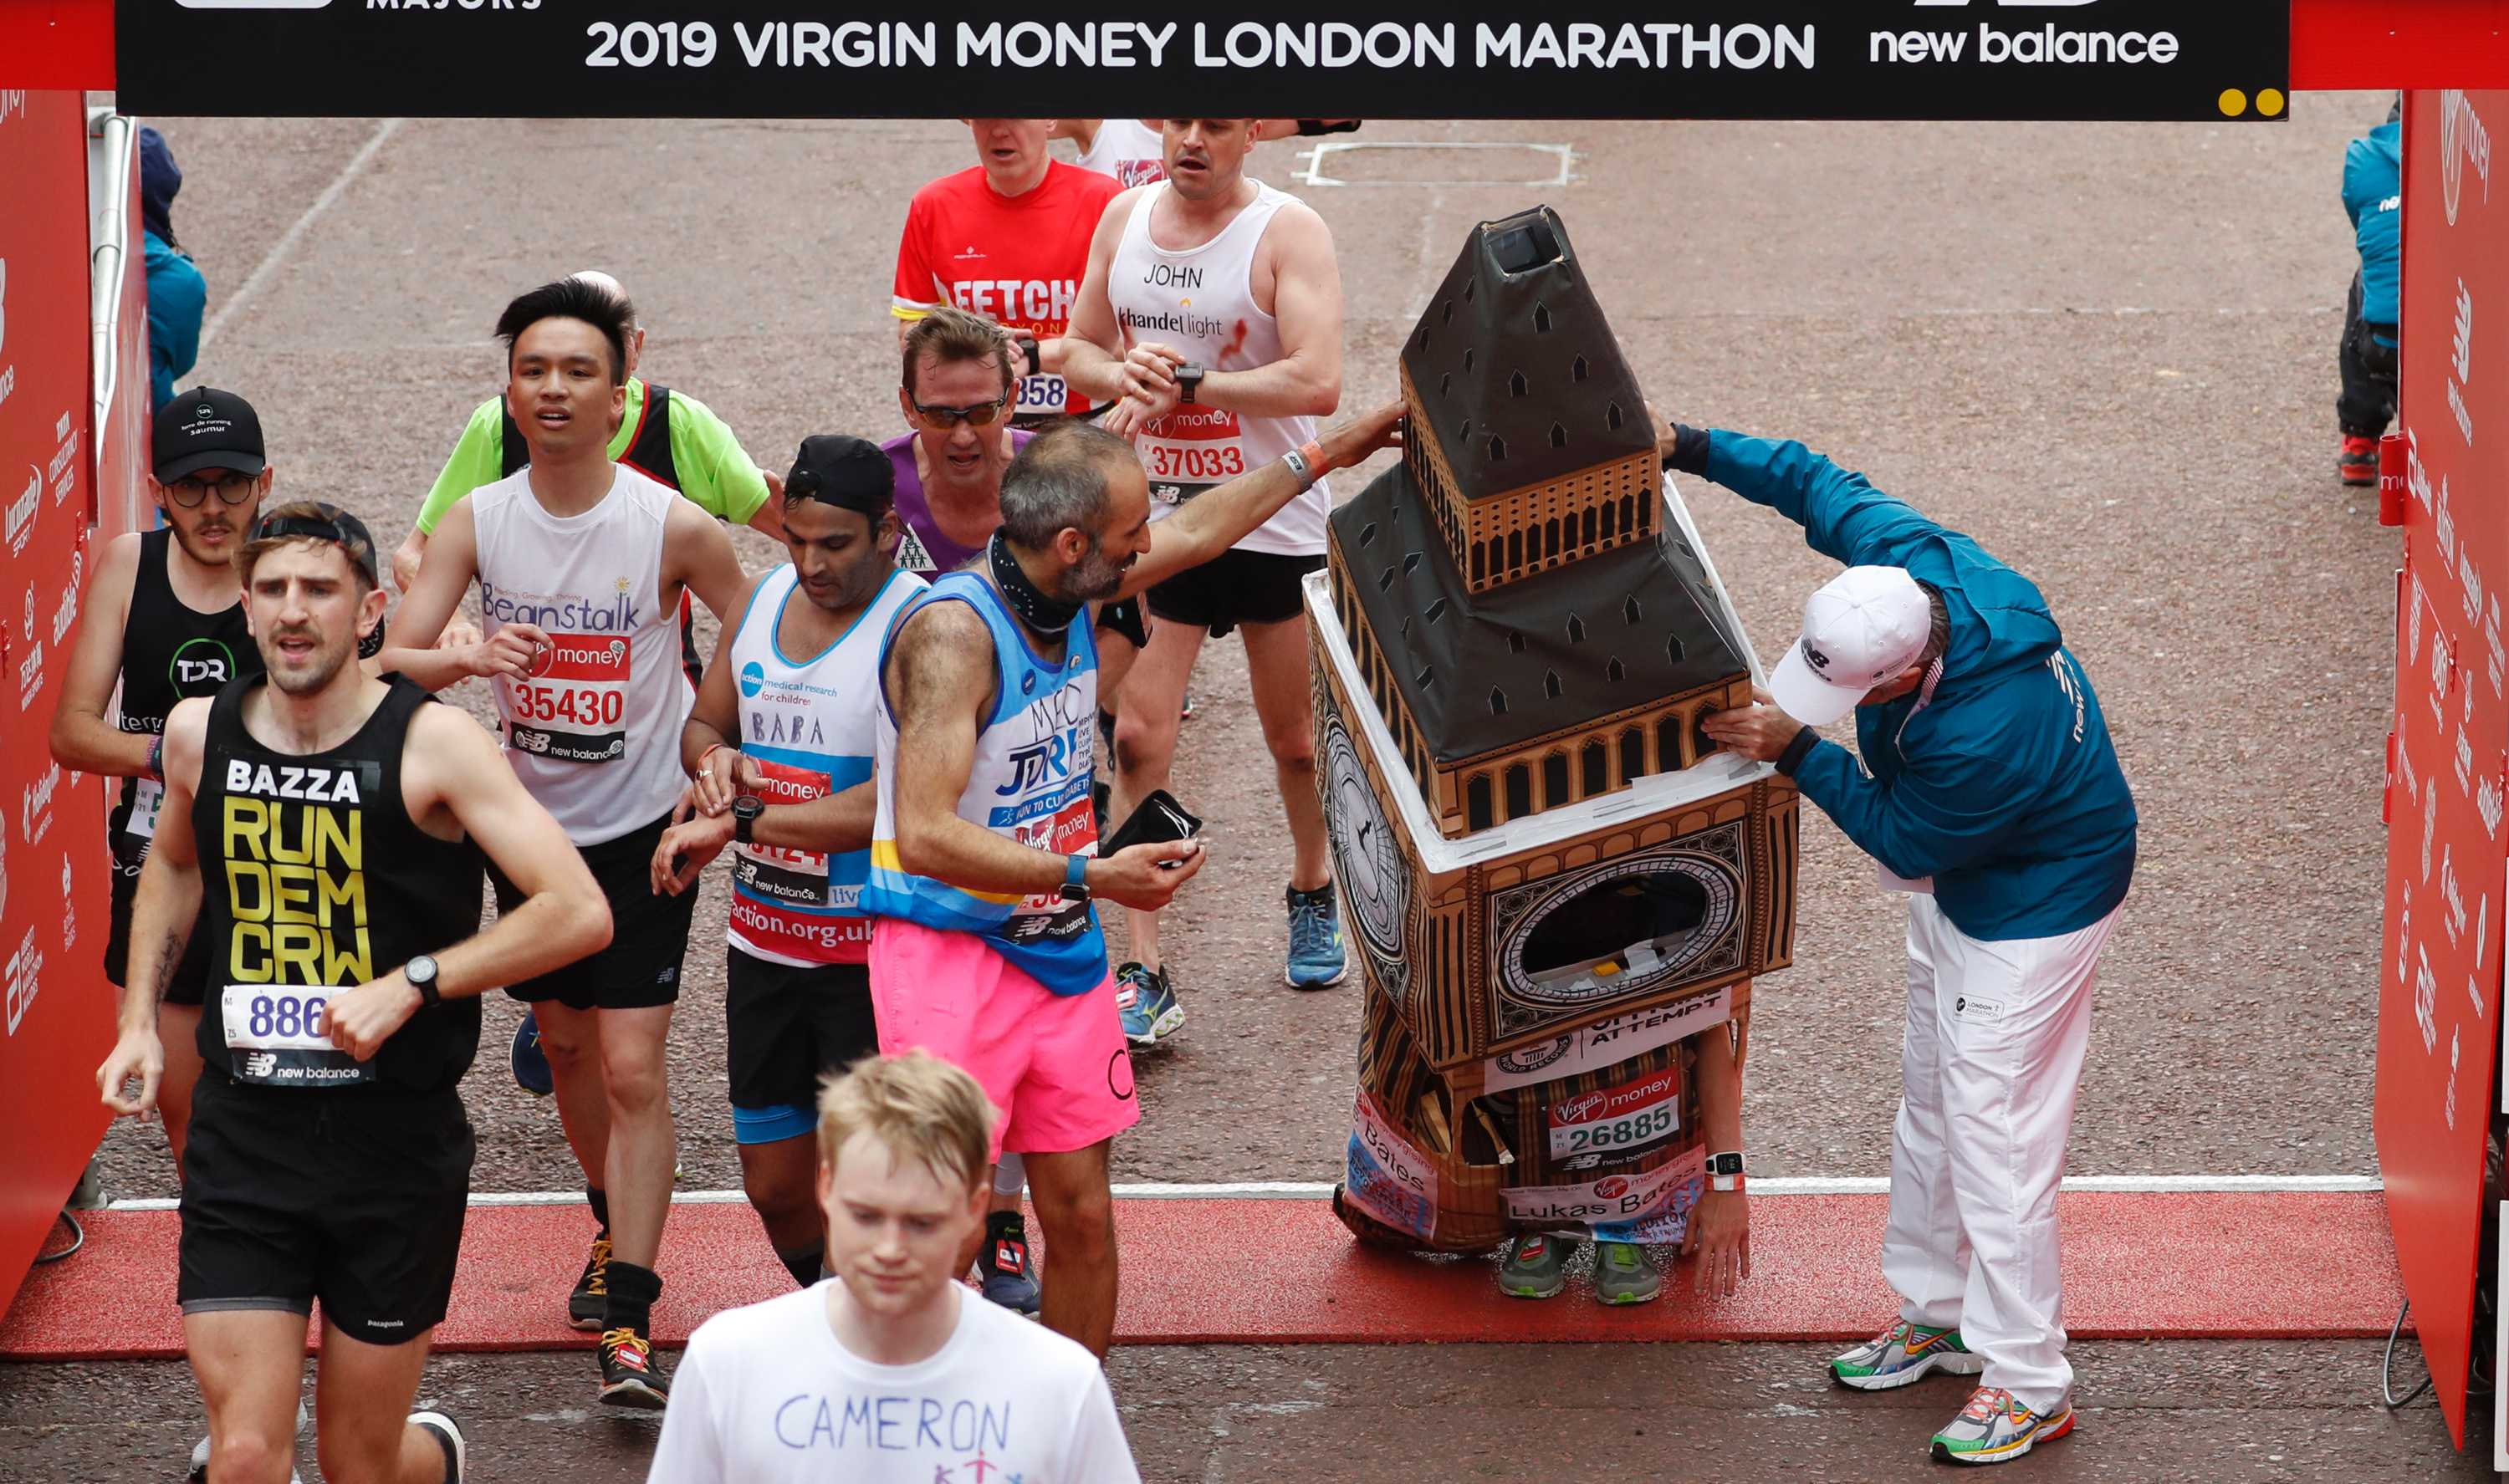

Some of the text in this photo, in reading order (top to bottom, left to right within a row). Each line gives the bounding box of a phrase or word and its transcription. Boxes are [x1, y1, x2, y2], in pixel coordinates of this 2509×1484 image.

[585, 21, 1815, 69] 2019 VIRGIN MONEY LONDON MARATHON
[1870, 23, 2179, 63] new balance
[1143, 264, 1203, 288] JOHN
[1118, 307, 1224, 339] khandel light
[190, 426, 225, 436] saumur
[1152, 446, 1244, 477] 37033
[13, 523, 32, 559] SPORT
[482, 582, 640, 632] Beanstalk
[176, 659, 227, 682] TDR
[556, 647, 626, 669] money
[514, 683, 624, 727] 35430
[761, 691, 812, 706] for children
[764, 680, 838, 698] medical research
[752, 711, 825, 746] BABA
[551, 746, 612, 761] new balanc
[226, 758, 360, 804] BAZZA
[223, 795, 362, 871] RUN
[224, 859, 368, 929] DEM
[755, 880, 772, 893] new
[229, 920, 374, 987] CRW
[1591, 993, 1722, 1047] ATTEMPT
[277, 1066, 360, 1079] new balance
[1557, 1076, 1672, 1123] Virgin money
[1569, 1104, 1672, 1153] 26885
[1364, 1119, 1425, 1192] Bates
[1602, 1158, 1625, 1166] new
[1511, 1164, 1698, 1218] Lukas Bates
[774, 1393, 1010, 1451] CAMERON
